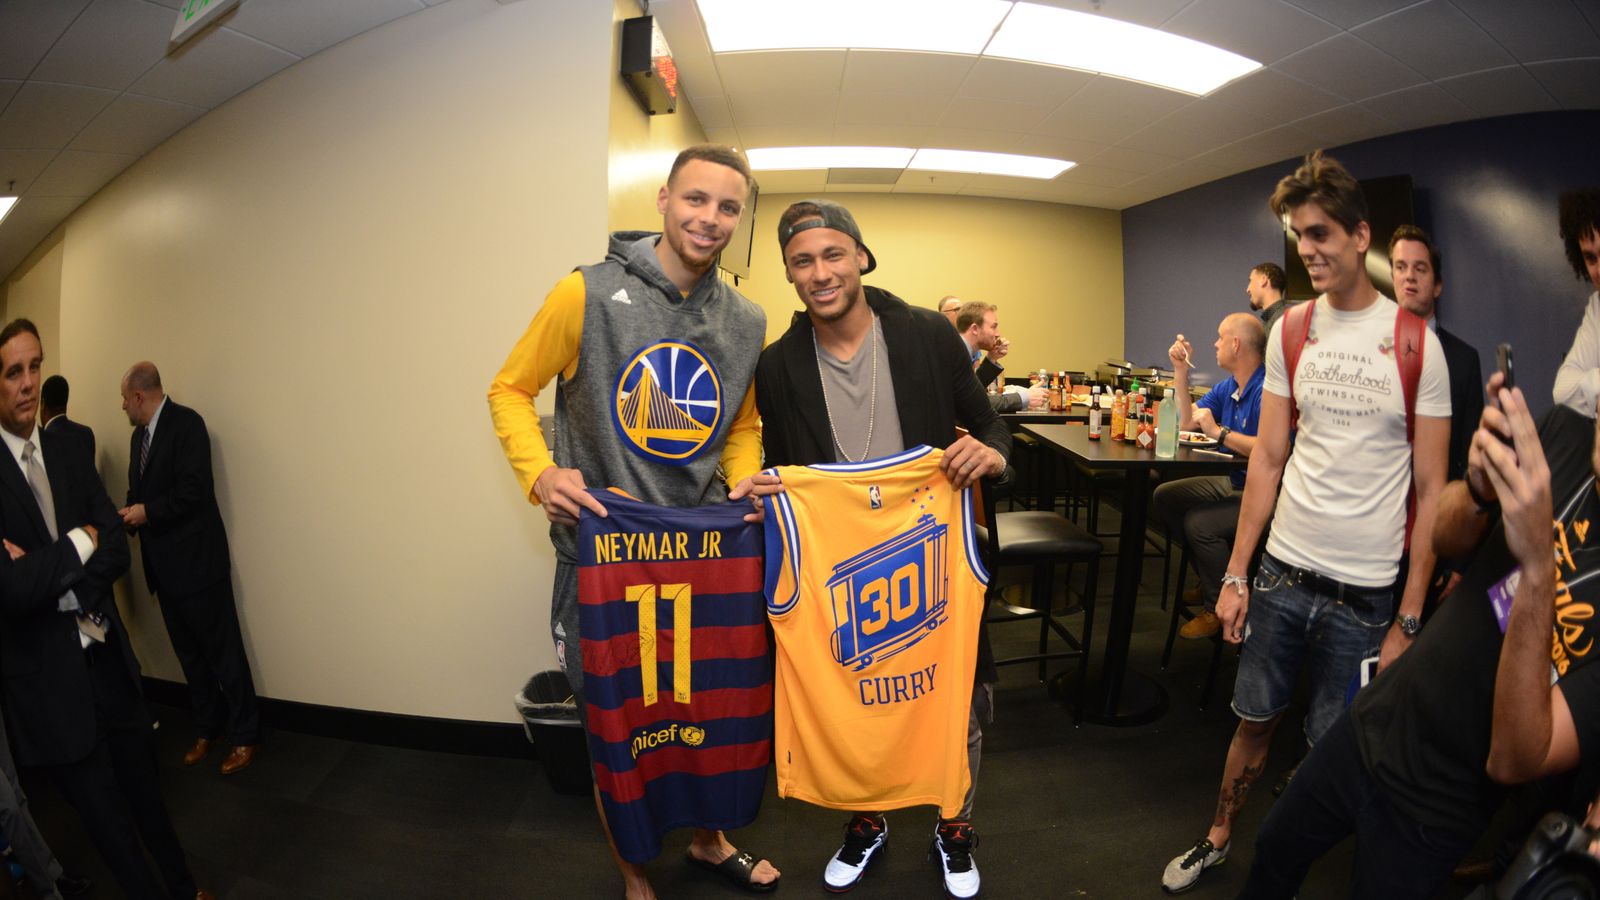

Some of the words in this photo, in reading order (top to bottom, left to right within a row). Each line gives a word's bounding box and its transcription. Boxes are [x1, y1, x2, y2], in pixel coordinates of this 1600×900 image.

[1318, 351, 1373, 365] ORIGINAL
[1310, 387, 1347, 399] TWINS
[595, 531, 689, 564] NEYMAR
[698, 530, 722, 559] JR
[860, 562, 919, 636] 30
[625, 583, 692, 708] 11
[859, 663, 938, 706] CURRY
